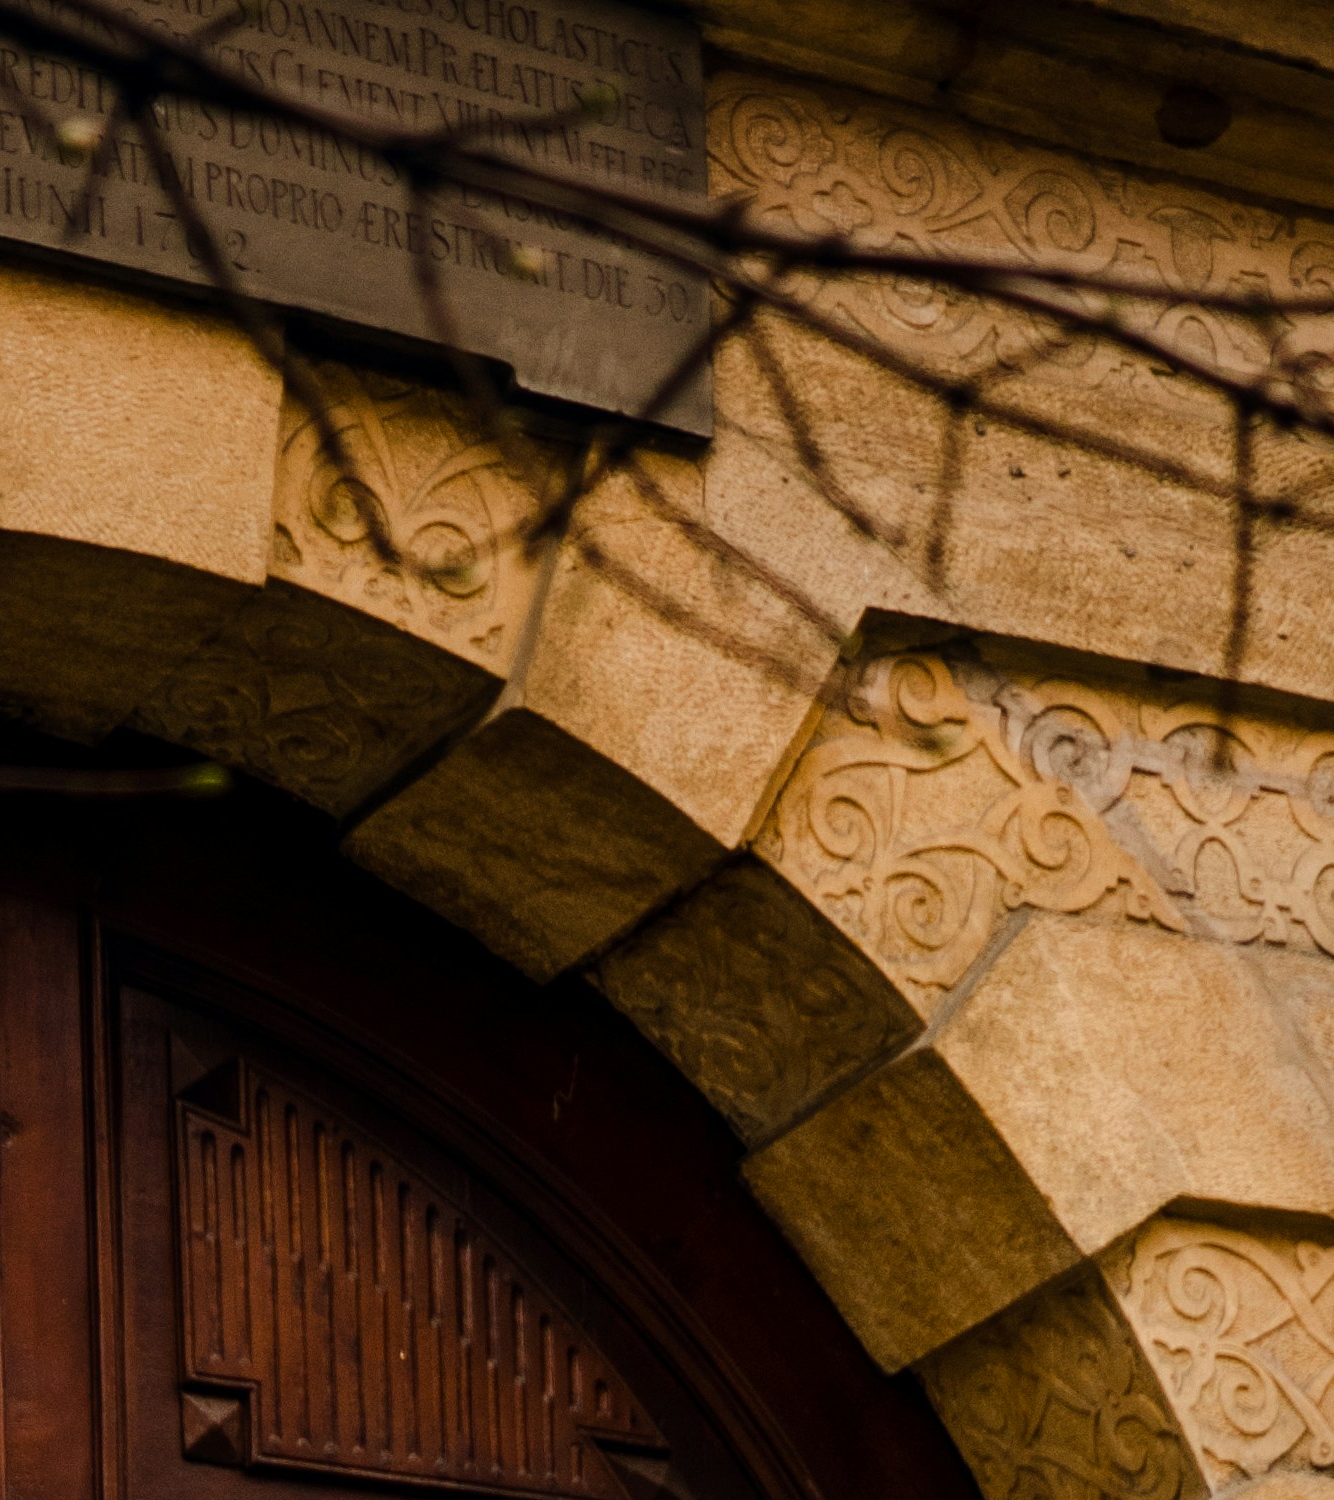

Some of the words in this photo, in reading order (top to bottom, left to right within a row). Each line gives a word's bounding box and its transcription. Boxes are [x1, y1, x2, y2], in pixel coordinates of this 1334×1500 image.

[135, 204, 261, 274] 172.
[206, 161, 343, 234] PROPRIO
[430, 218, 574, 296] STRUIT.
[581, 257, 635, 309] DIE
